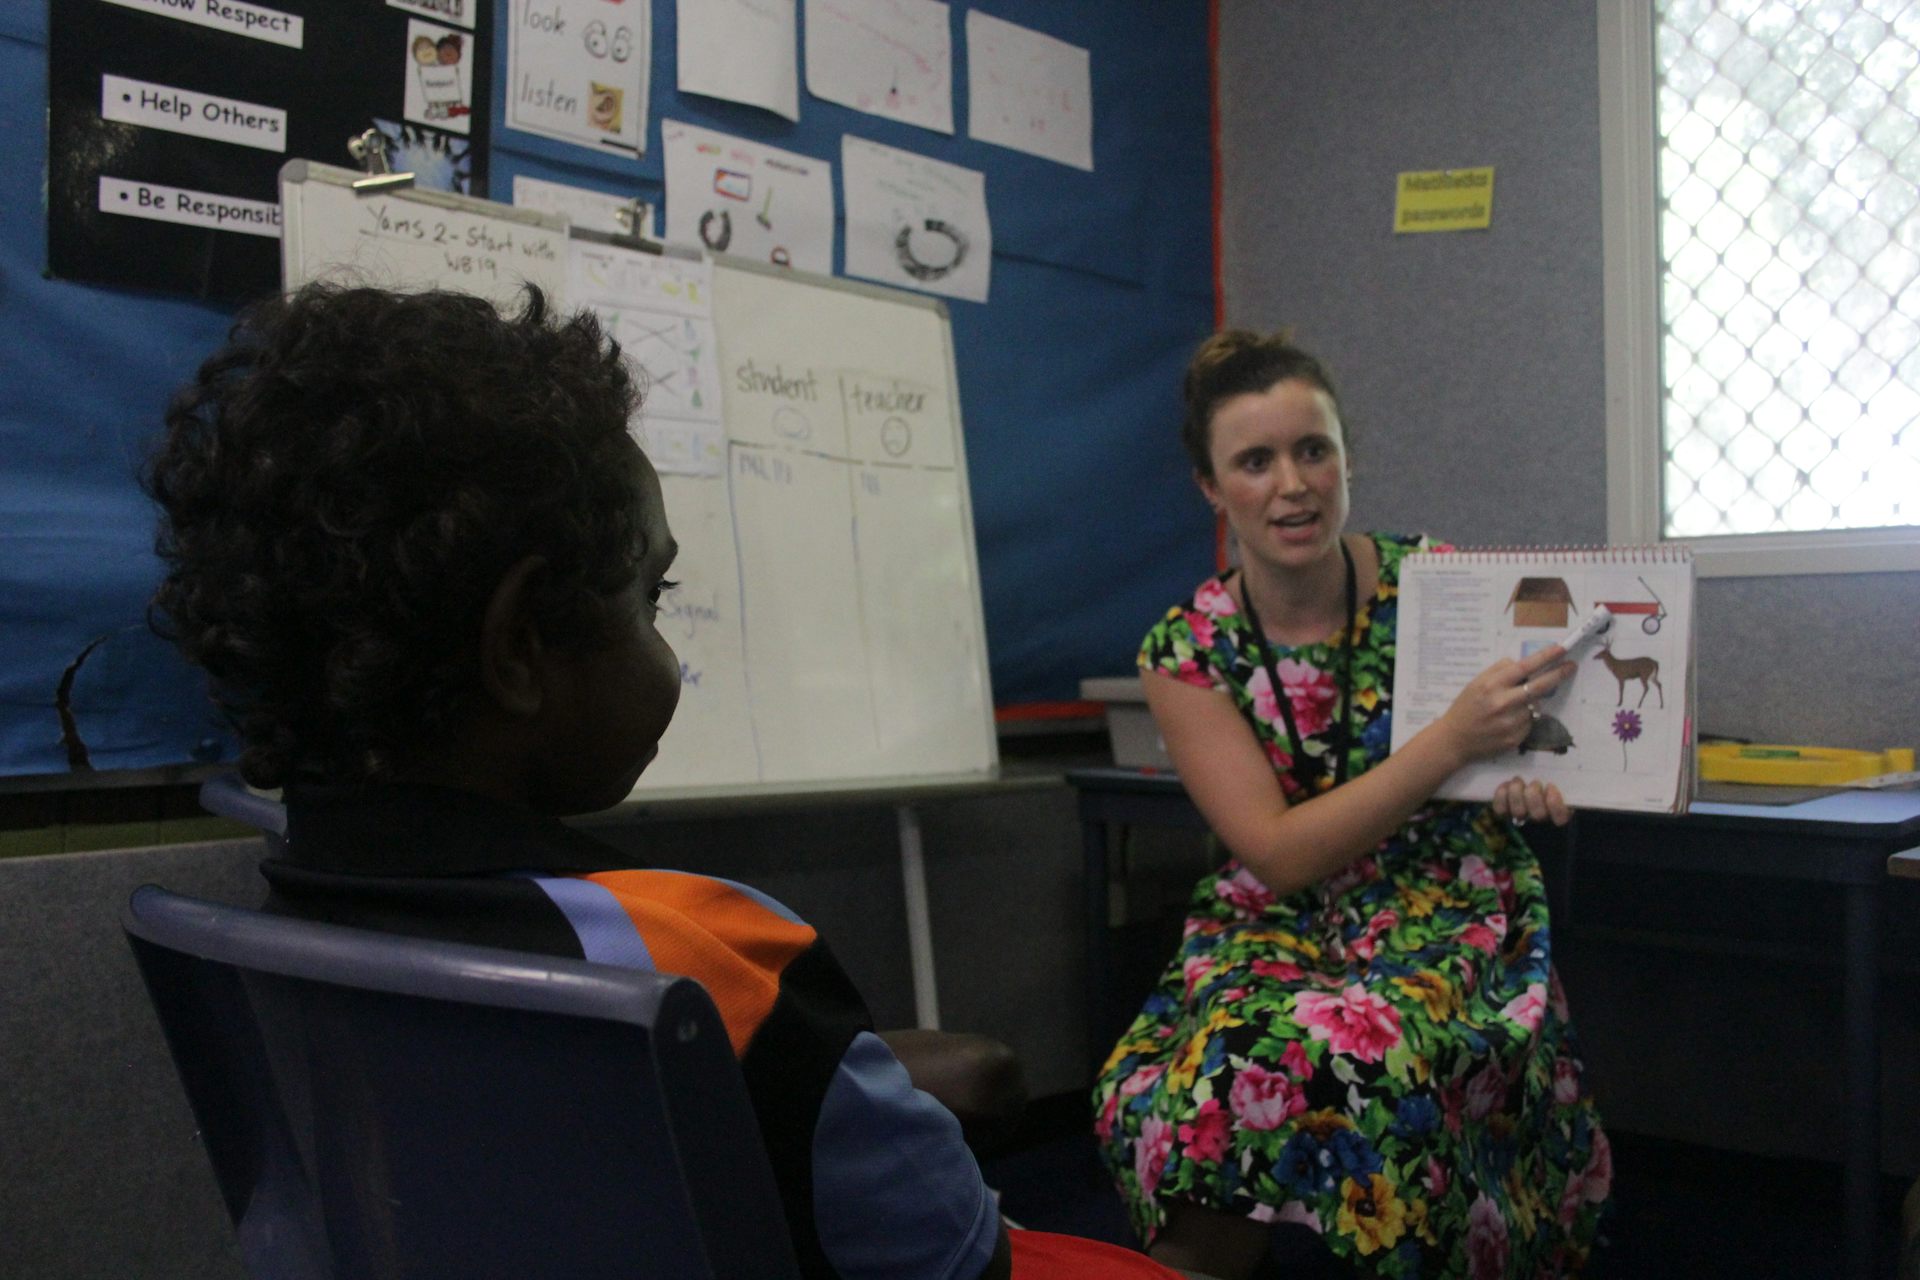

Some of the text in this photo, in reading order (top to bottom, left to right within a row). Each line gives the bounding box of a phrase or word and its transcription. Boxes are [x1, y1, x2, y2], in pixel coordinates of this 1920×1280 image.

[206, 0, 291, 32] Respect
[522, 0, 567, 35] look
[520, 73, 578, 115] listen
[141, 90, 280, 134] Help Others
[138, 187, 166, 210] Be
[365, 205, 424, 239] Yams
